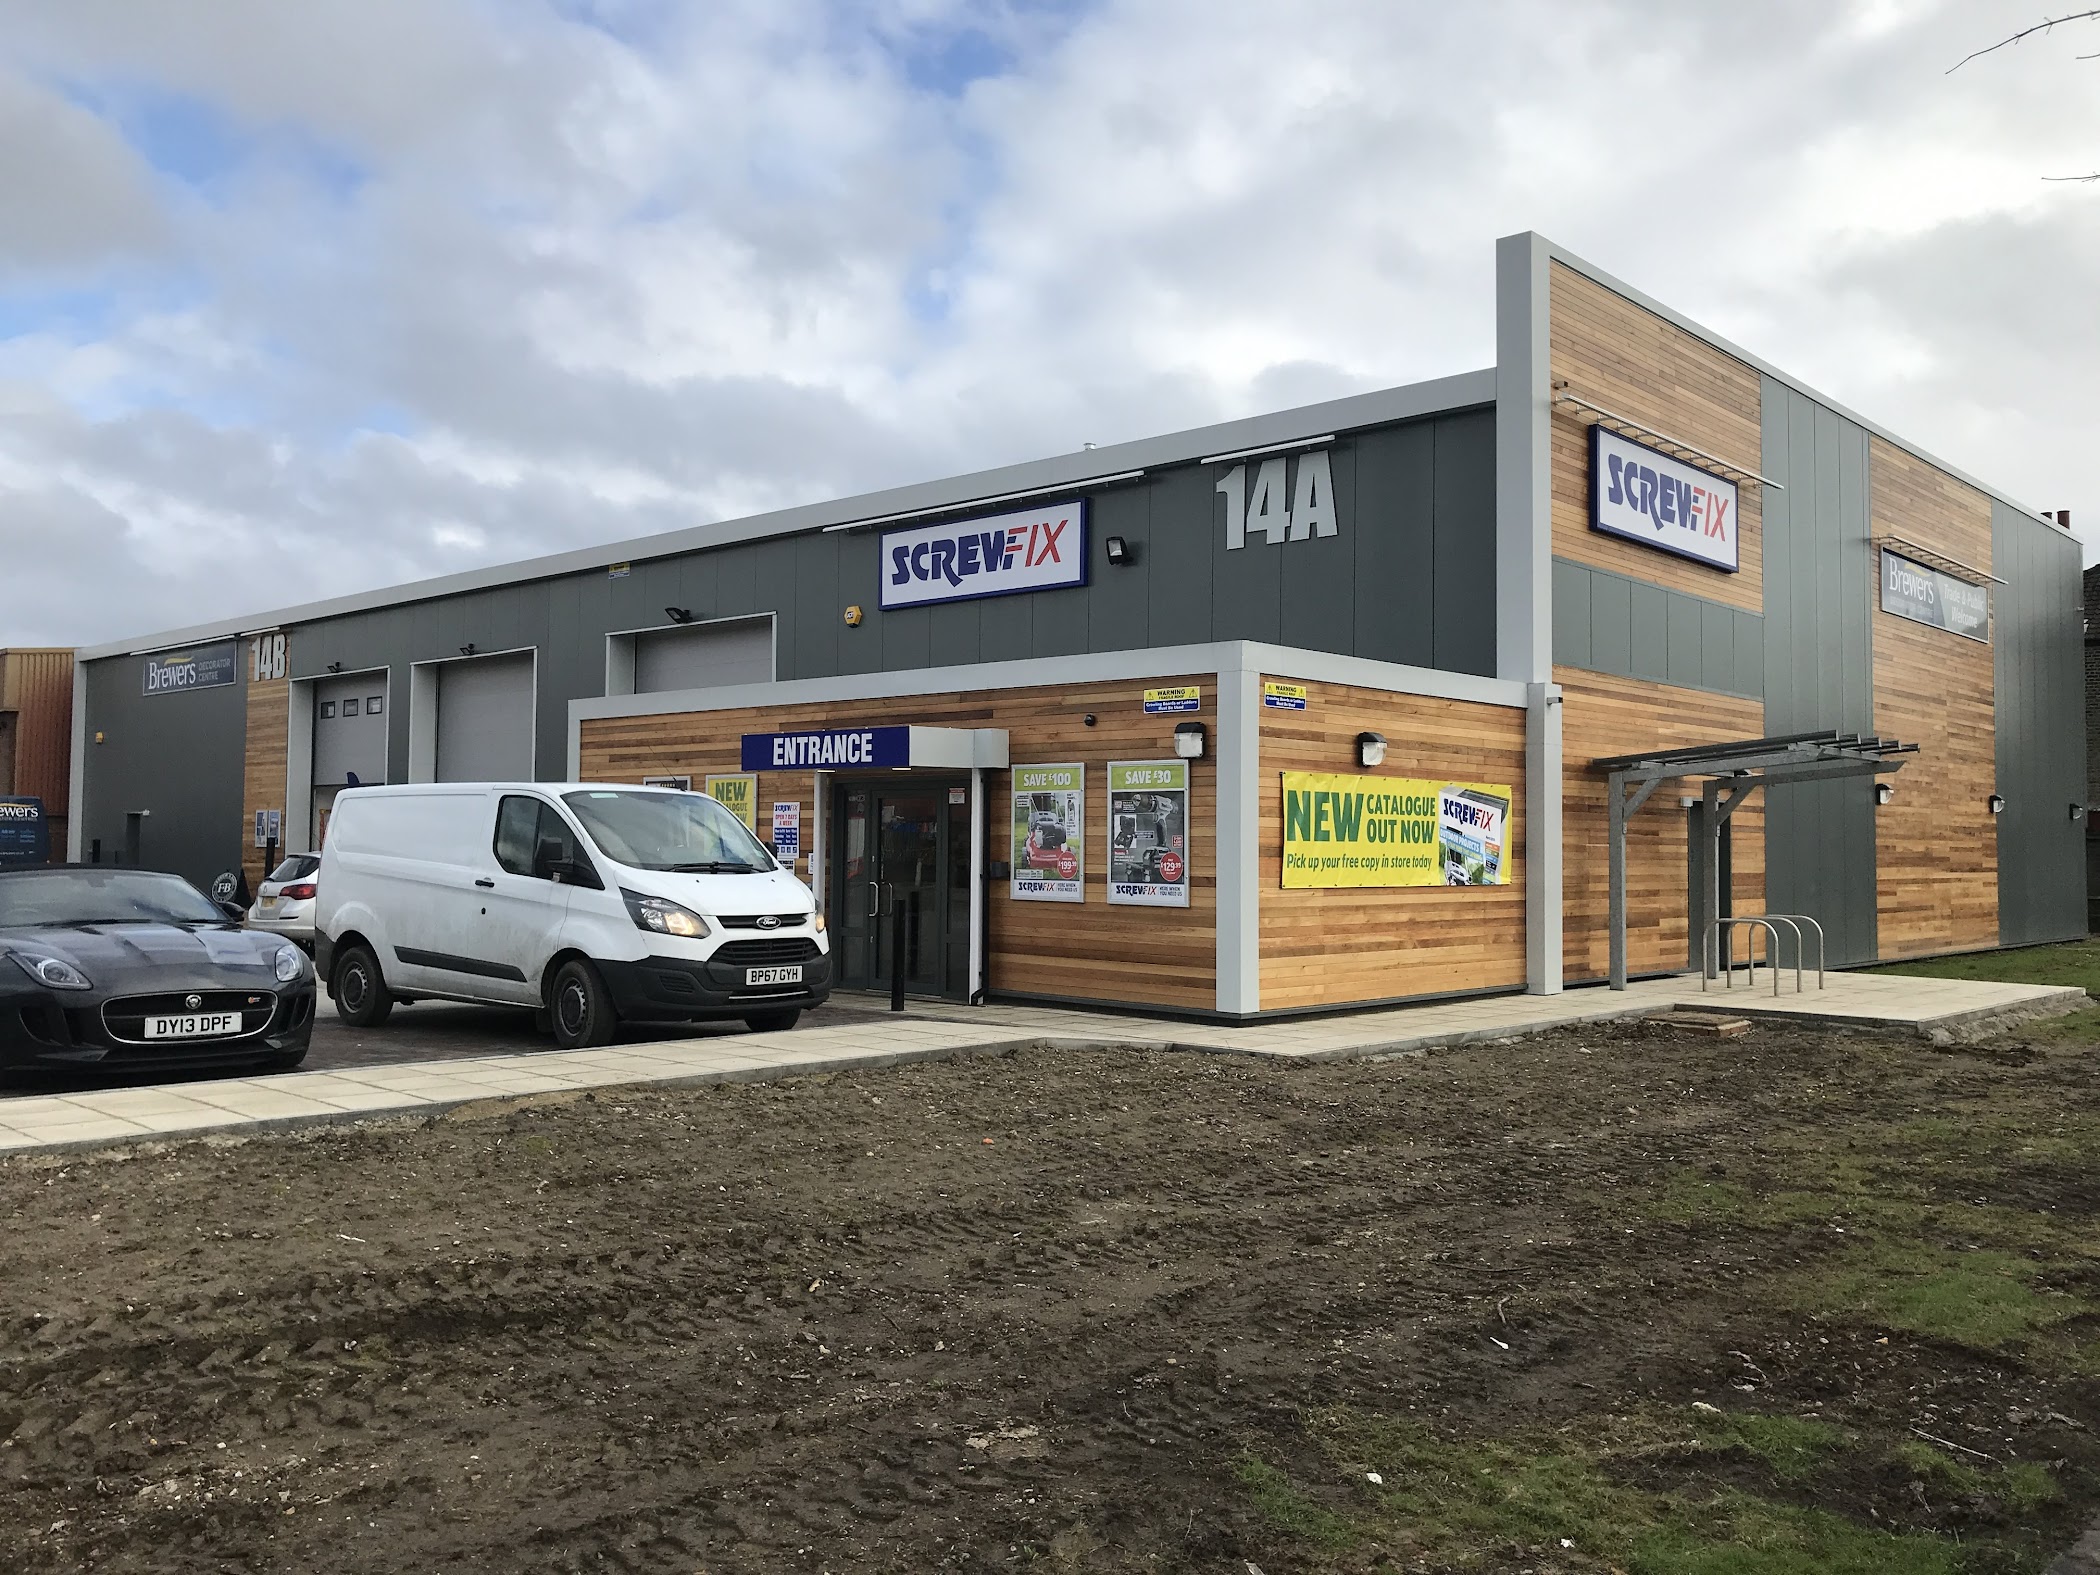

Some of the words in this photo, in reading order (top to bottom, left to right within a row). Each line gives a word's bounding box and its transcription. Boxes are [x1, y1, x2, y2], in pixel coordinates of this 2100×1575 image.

[1216, 450, 1338, 550] 14A
[1608, 453, 1729, 542] SCREWFIX
[892, 519, 1068, 587] SCREWFIX
[1889, 557, 1934, 604] Brewers
[1944, 583, 1960, 603] Trade
[1967, 592, 1984, 612] Public
[1951, 606, 1978, 628] Welcome
[252, 634, 287, 681] 14B
[148, 662, 196, 690] Brewers
[773, 733, 873, 765] ENTRANCE
[1024, 773, 1046, 787] SAVE
[1050, 772, 1071, 786] £100
[1125, 770, 1151, 785] SAVE
[1153, 770, 1171, 784] £30
[716, 782, 747, 801] NEW
[1287, 790, 1364, 842] NEW
[1367, 794, 1436, 816] CATALOGUE
[1444, 798, 1494, 831] SCREWFIX
[1367, 818, 1397, 843] OUT
[1400, 820, 1435, 844] NOW
[1287, 853, 1306, 868] Pick
[1308, 857, 1319, 872] up
[1321, 856, 1340, 872] your
[1341, 853, 1359, 872] free
[1361, 857, 1380, 871] copy
[1381, 853, 1389, 868] in
[1391, 855, 1410, 868] store
[1412, 854, 1432, 871] today
[1018, 882, 1055, 893] SCREWFIX
[1116, 885, 1157, 896] SCREWFIX
[751, 969, 777, 982] BP67
[780, 968, 798, 980] GYH
[156, 1018, 195, 1034] DY13
[200, 1016, 232, 1031] DPF
